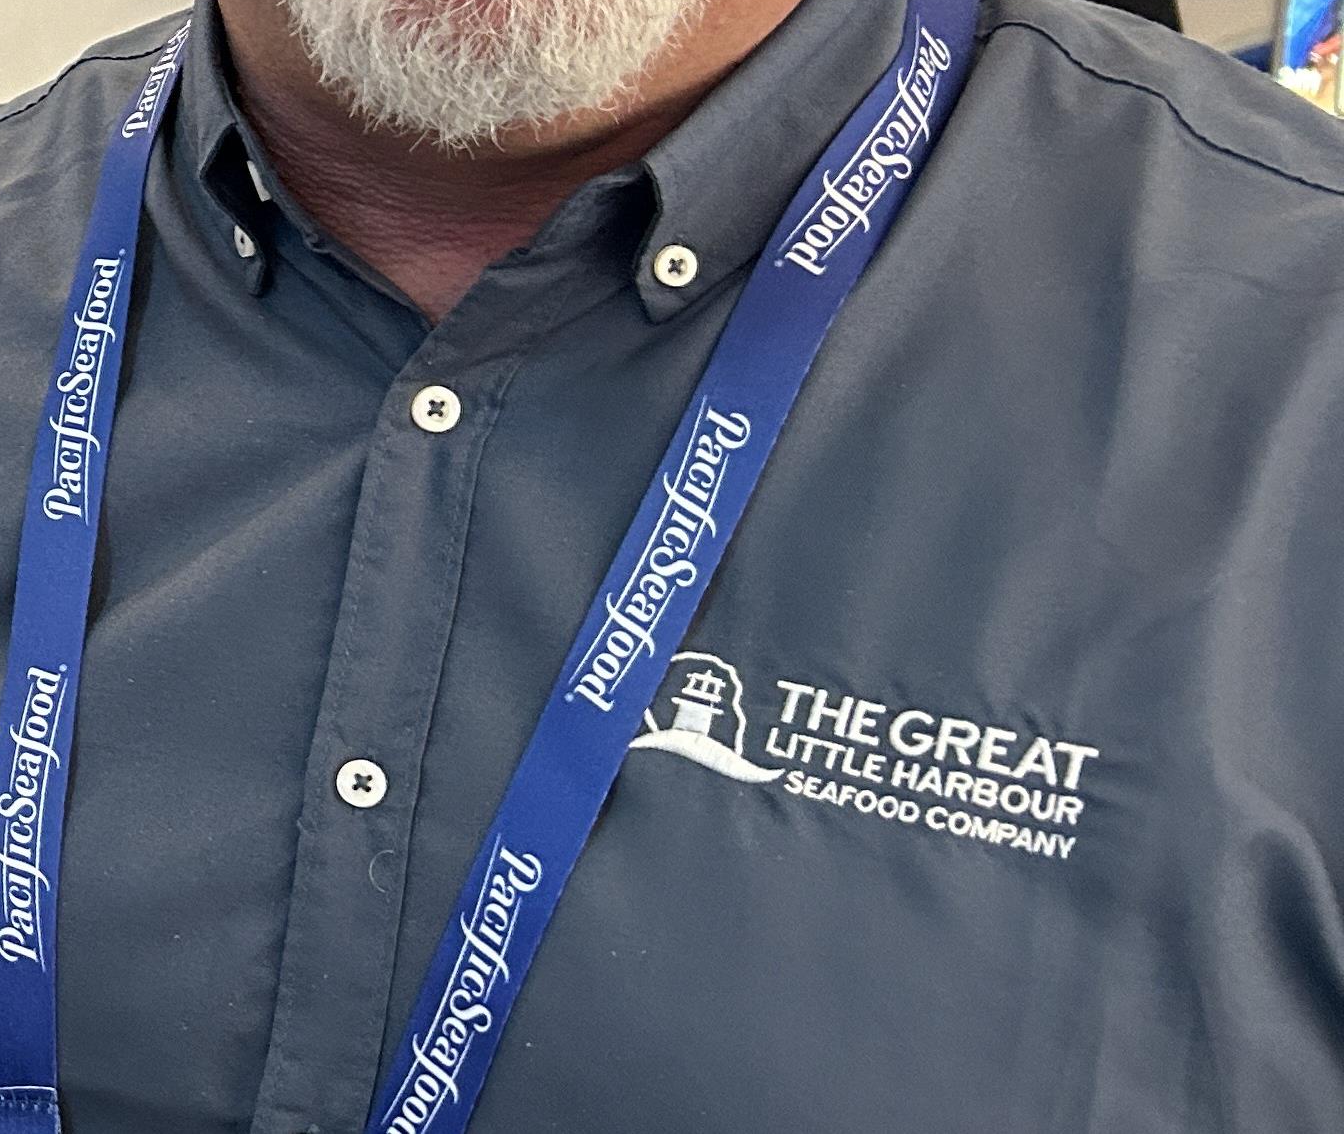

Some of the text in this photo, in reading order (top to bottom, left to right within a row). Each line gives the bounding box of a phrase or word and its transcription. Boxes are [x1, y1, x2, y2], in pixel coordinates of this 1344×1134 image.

[43, 257, 121, 523] PacificSeafood
[574, 405, 752, 712] PacificSeafood
[765, 727, 1086, 826] LITTLE HARBOUR
[776, 678, 1100, 791] THE GREAT
[783, 769, 1078, 860] SEAFOOD COMPANY
